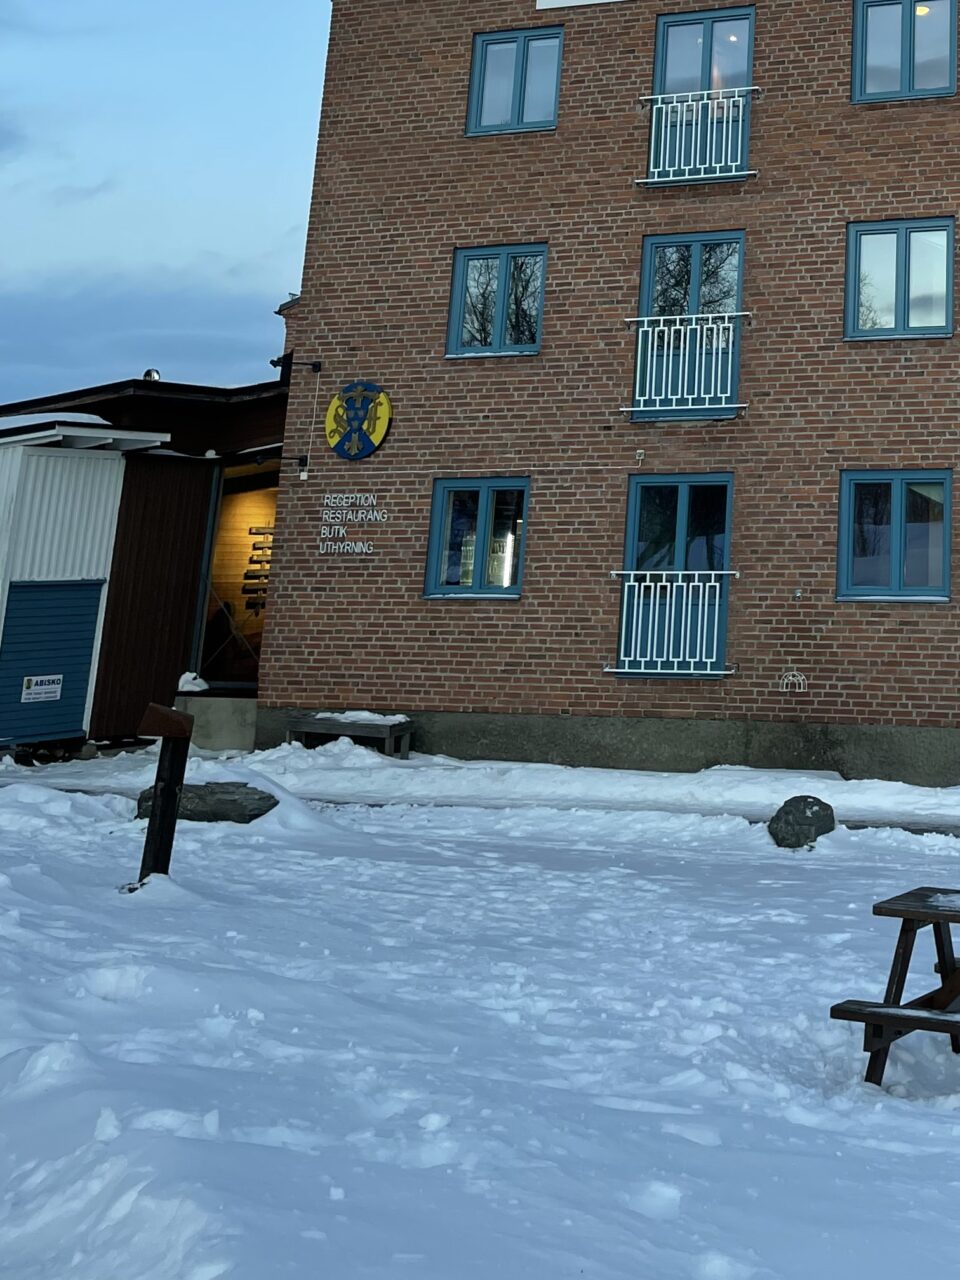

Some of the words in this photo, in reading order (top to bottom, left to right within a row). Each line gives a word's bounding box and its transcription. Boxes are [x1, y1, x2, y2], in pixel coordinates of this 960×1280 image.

[324, 494, 377, 506] RECEPTION
[322, 509, 388, 522] RESTAURANG
[320, 525, 347, 538] BUTIK
[320, 541, 374, 553] UTHYRNING
